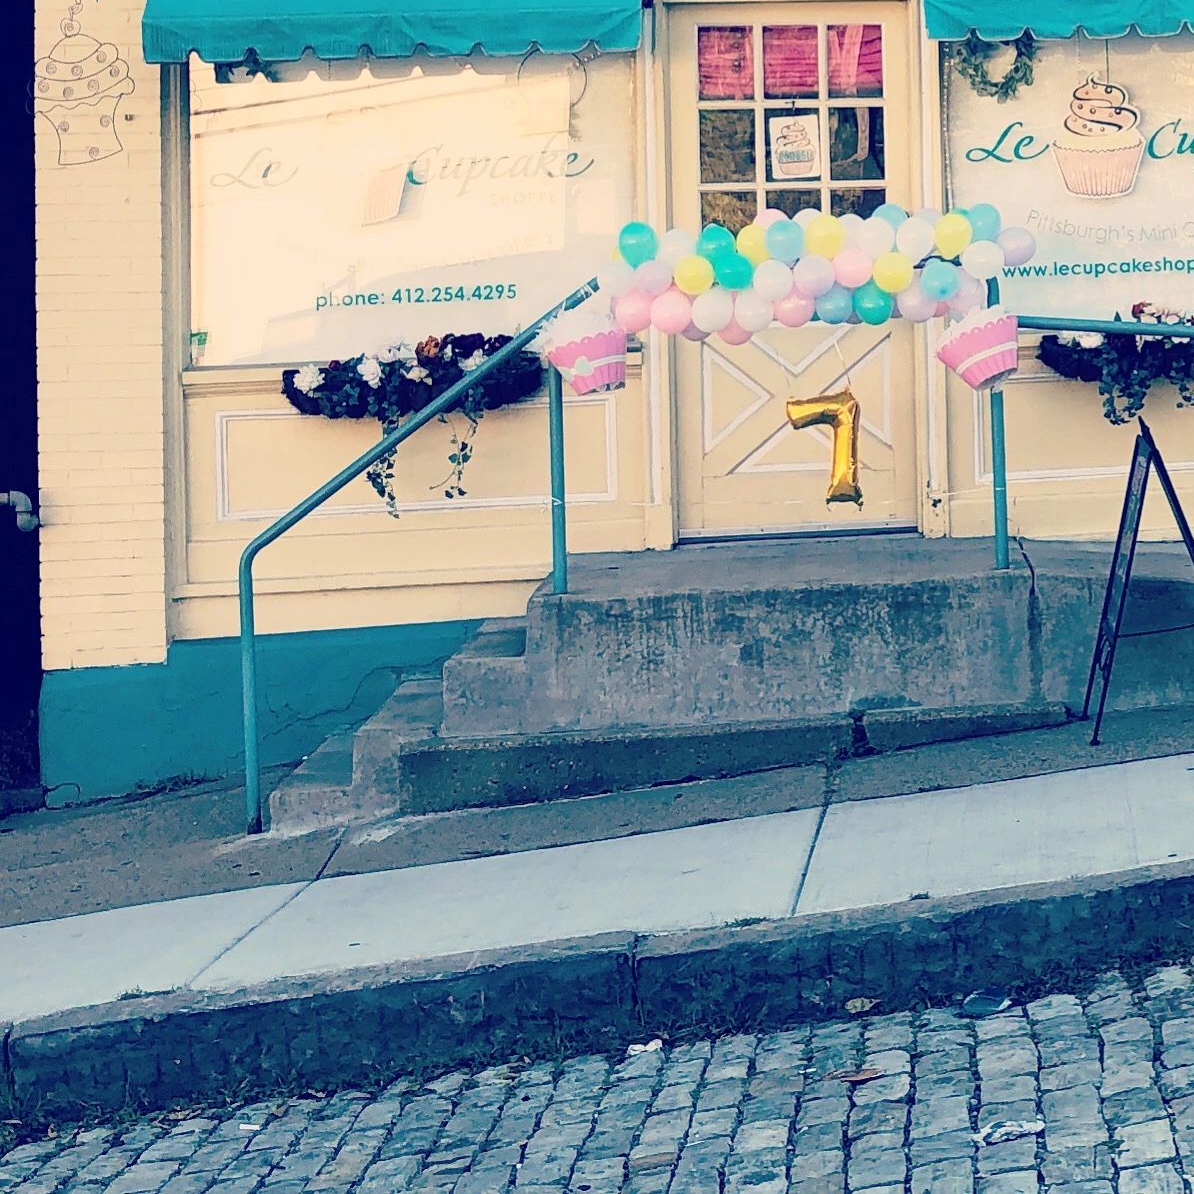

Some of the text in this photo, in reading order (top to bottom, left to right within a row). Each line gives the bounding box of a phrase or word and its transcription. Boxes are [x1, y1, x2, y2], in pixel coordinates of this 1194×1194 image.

[965, 120, 1050, 164] Le
[209, 133, 595, 198] Le Cupcake
[1025, 209, 1135, 245] Pittsburgh's
[1138, 225, 1178, 243] Mini
[391, 283, 518, 304] 412.254.4295
